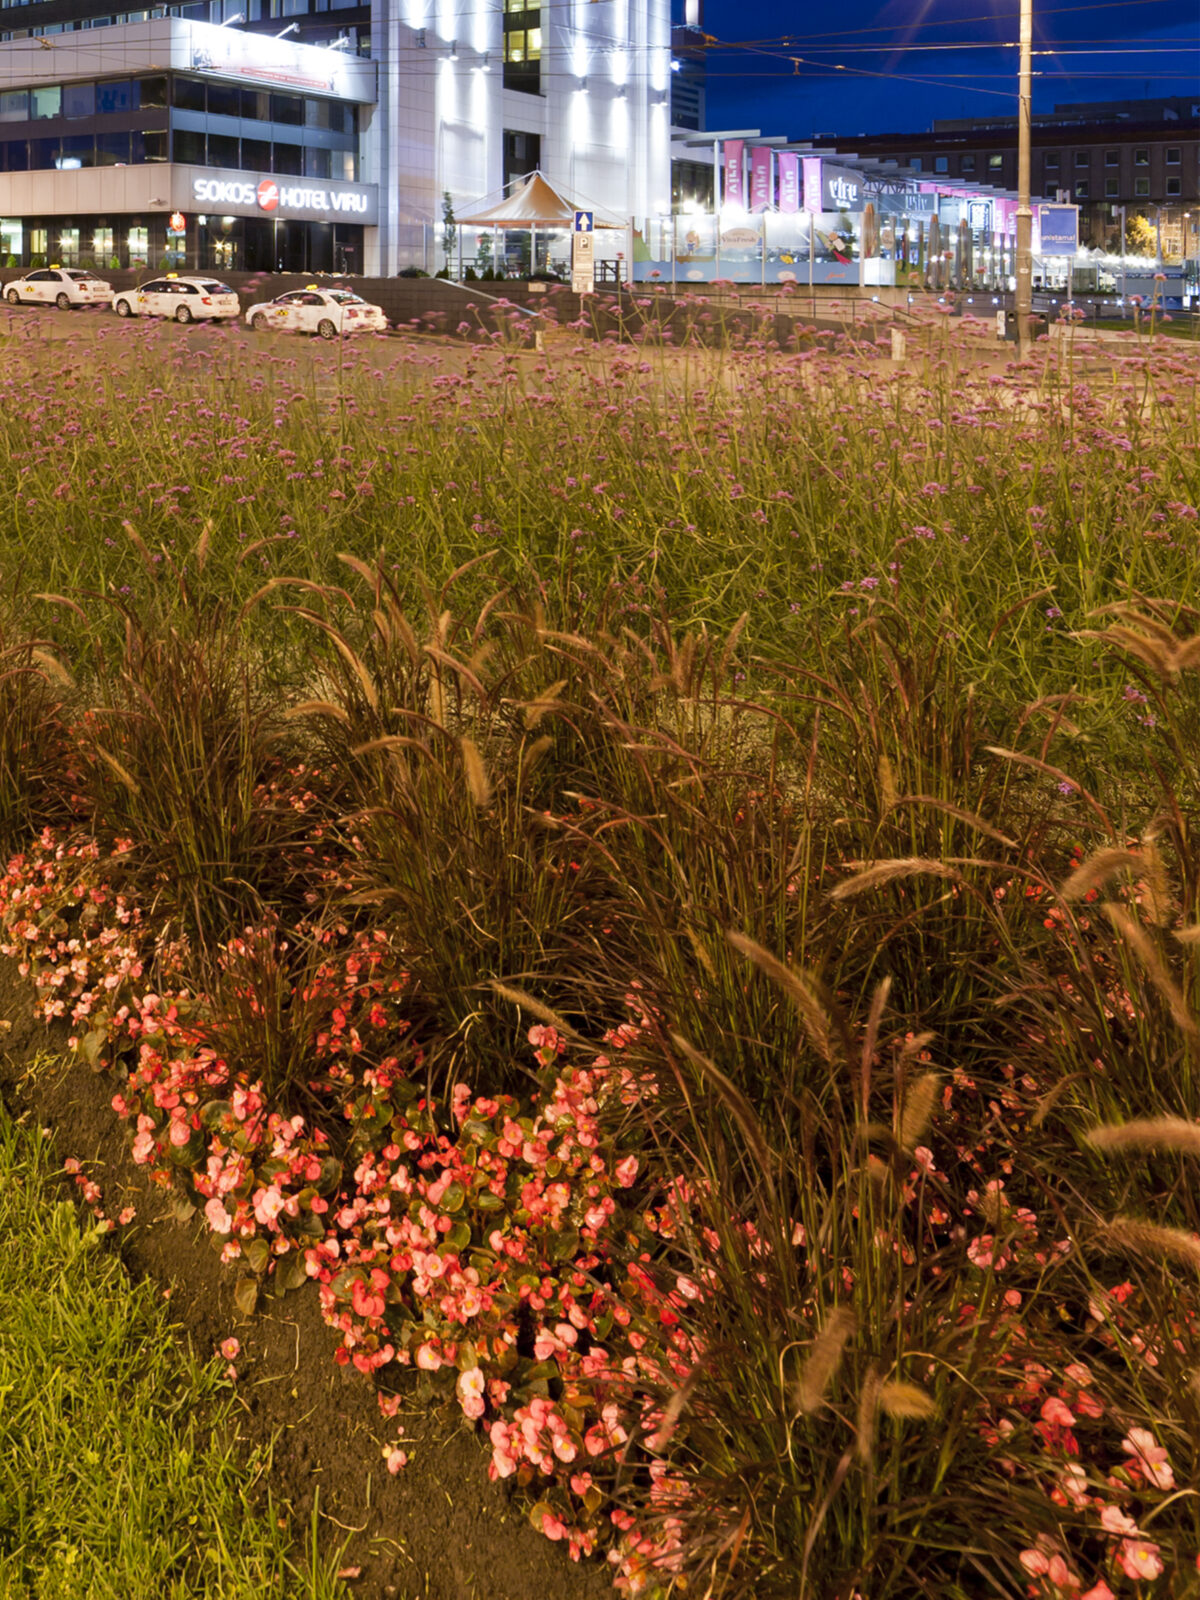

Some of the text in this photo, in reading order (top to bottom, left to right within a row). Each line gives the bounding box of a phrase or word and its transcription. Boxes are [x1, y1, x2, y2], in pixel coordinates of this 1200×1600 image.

[727, 159, 740, 194] viru
[756, 165, 768, 198] viru
[785, 171, 797, 203] viru
[829, 176, 858, 202] viru
[194, 179, 368, 213] SOKOS HOTEL VIRU
